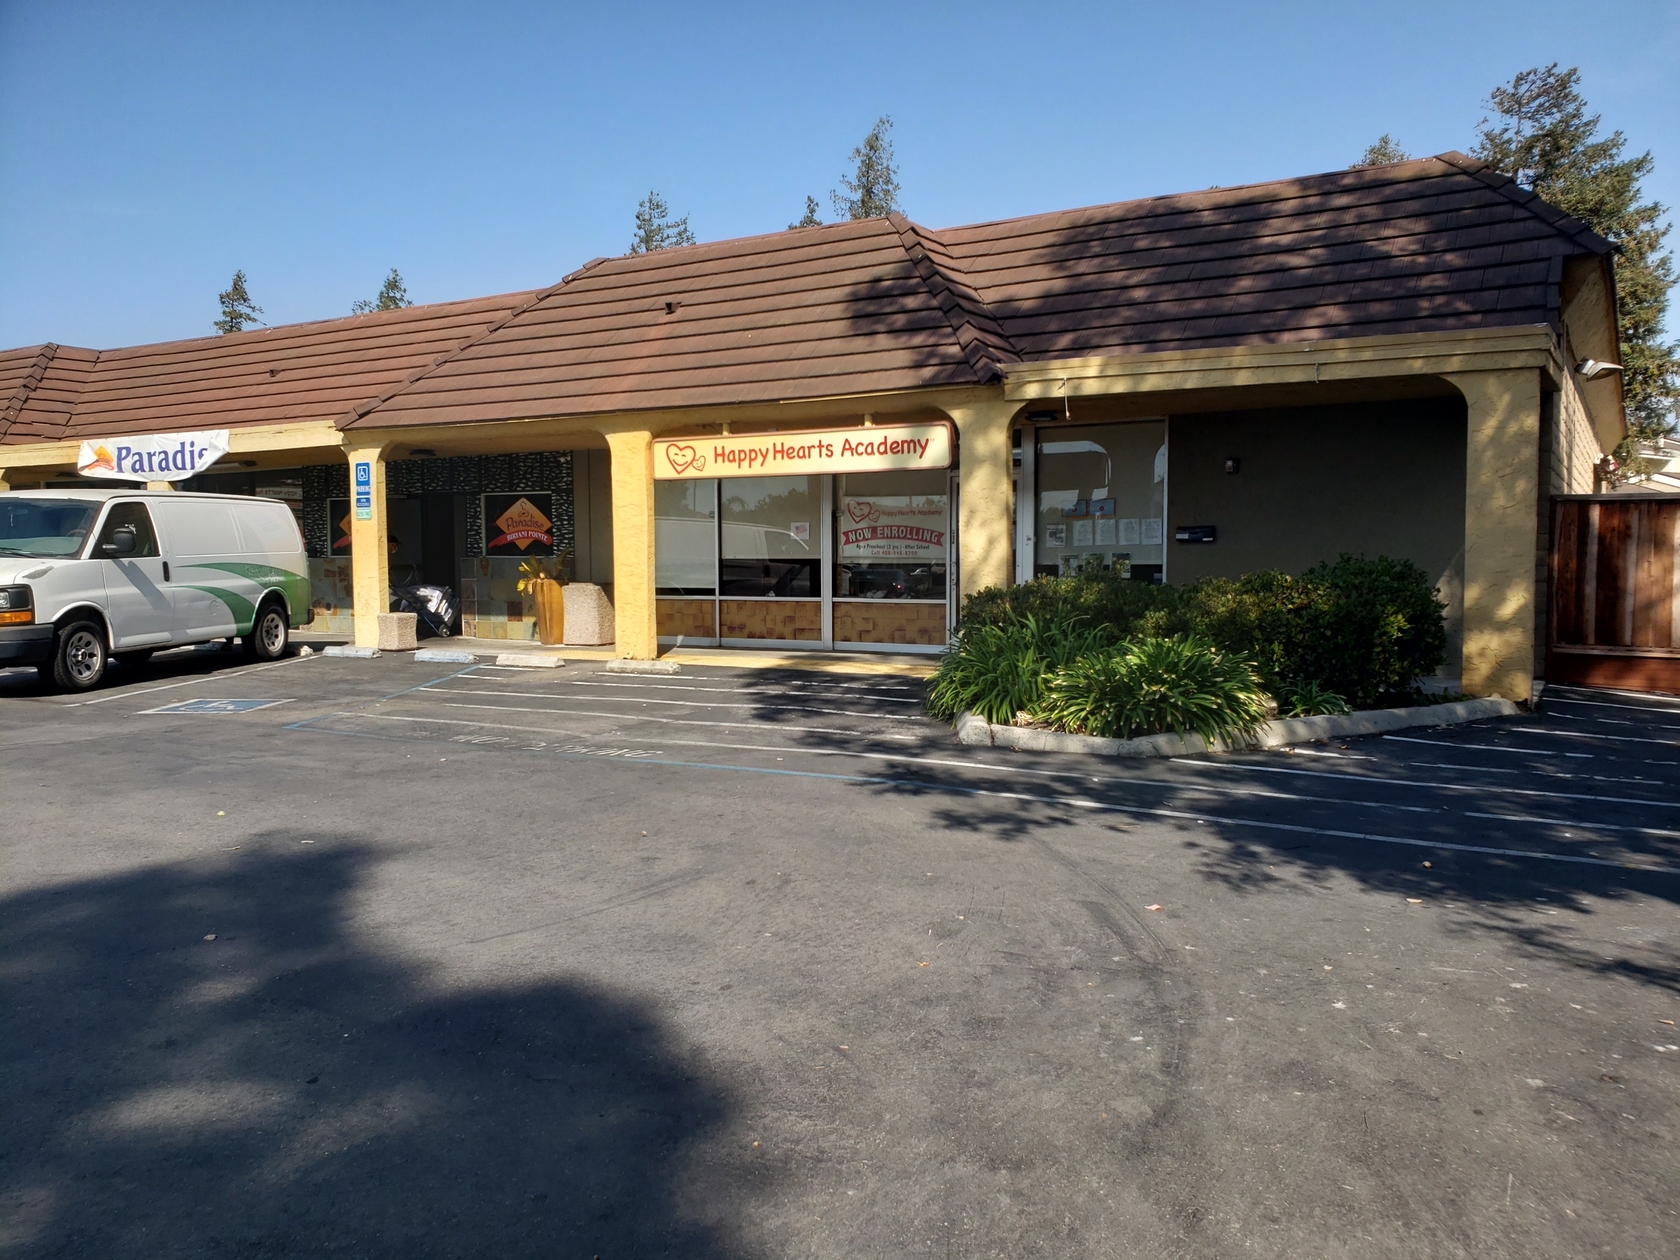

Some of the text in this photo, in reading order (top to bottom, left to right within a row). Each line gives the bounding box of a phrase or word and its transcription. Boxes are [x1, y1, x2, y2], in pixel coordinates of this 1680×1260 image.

[713, 435, 929, 469] Happy Hearts Academy
[917, 509, 943, 517] Academy
[505, 513, 545, 531] Paradise
[528, 531, 548, 542] POINTE
[848, 528, 872, 543] NOW
[877, 526, 939, 543] ENROLLING
